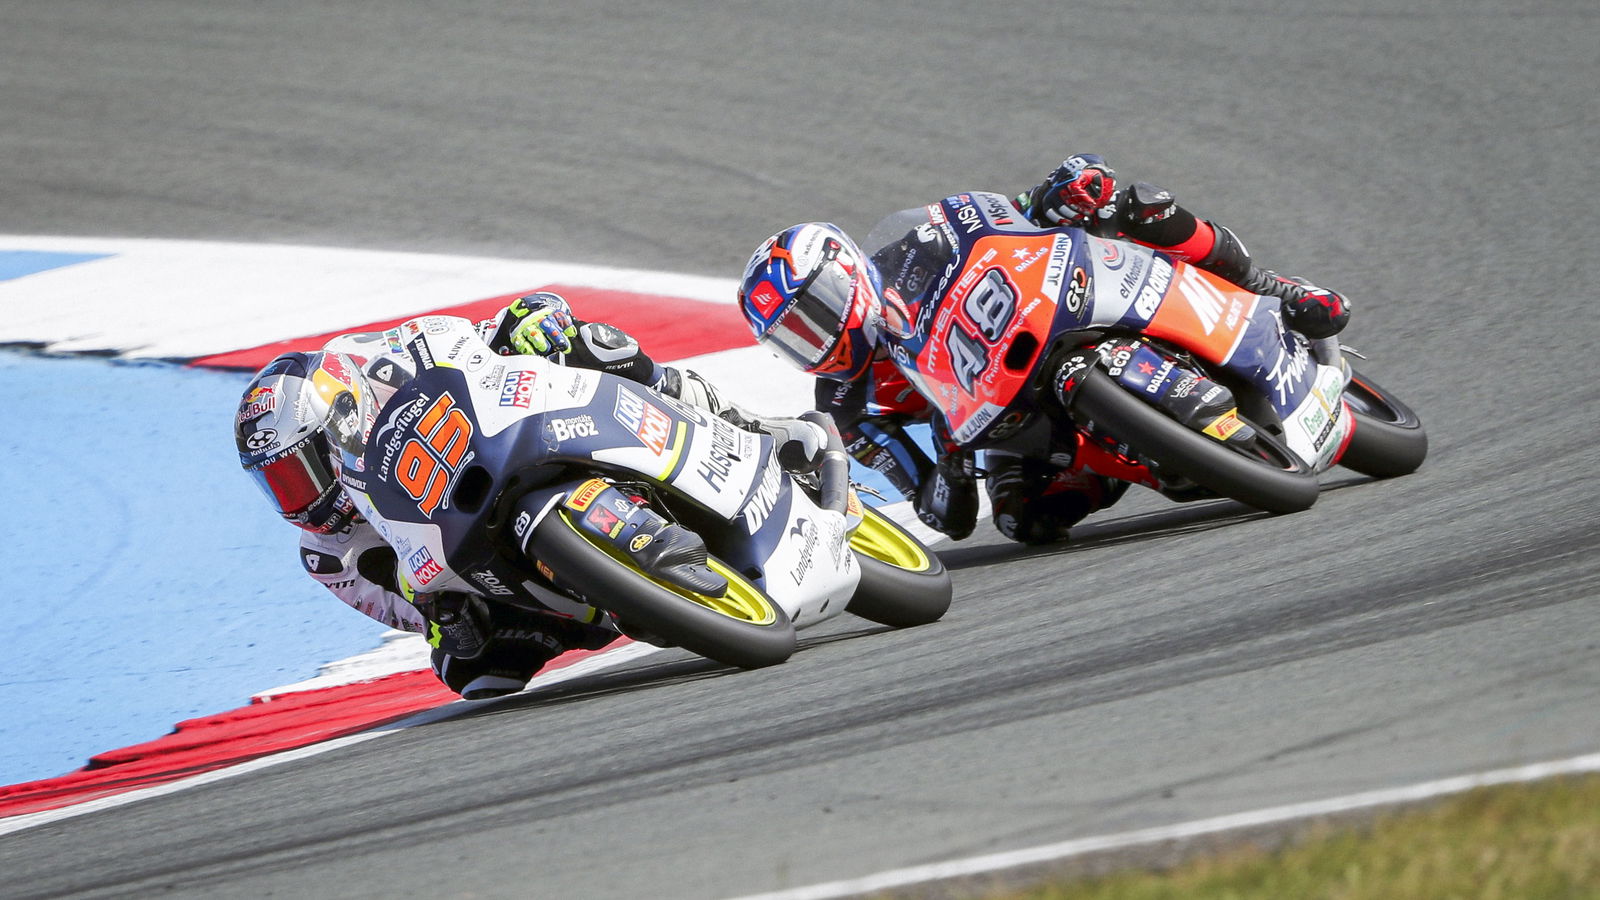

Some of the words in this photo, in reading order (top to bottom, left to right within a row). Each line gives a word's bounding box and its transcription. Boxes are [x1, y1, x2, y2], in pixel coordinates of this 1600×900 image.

[958, 206, 984, 234] MSI
[1014, 247, 1048, 272] DALLAS
[949, 269, 1014, 394] 48
[500, 372, 520, 406] LIQUI
[516, 370, 537, 408] MOLY
[252, 397, 276, 417] Bull
[378, 392, 430, 482] Landgeflügel
[551, 418, 600, 442] Broz
[260, 456, 276, 468] YOU
[279, 438, 311, 458] WINGS
[395, 391, 474, 520] 95
[572, 480, 606, 507] PIRELLI
[409, 548, 432, 570] LIQUI
[415, 560, 442, 584] MOLY
